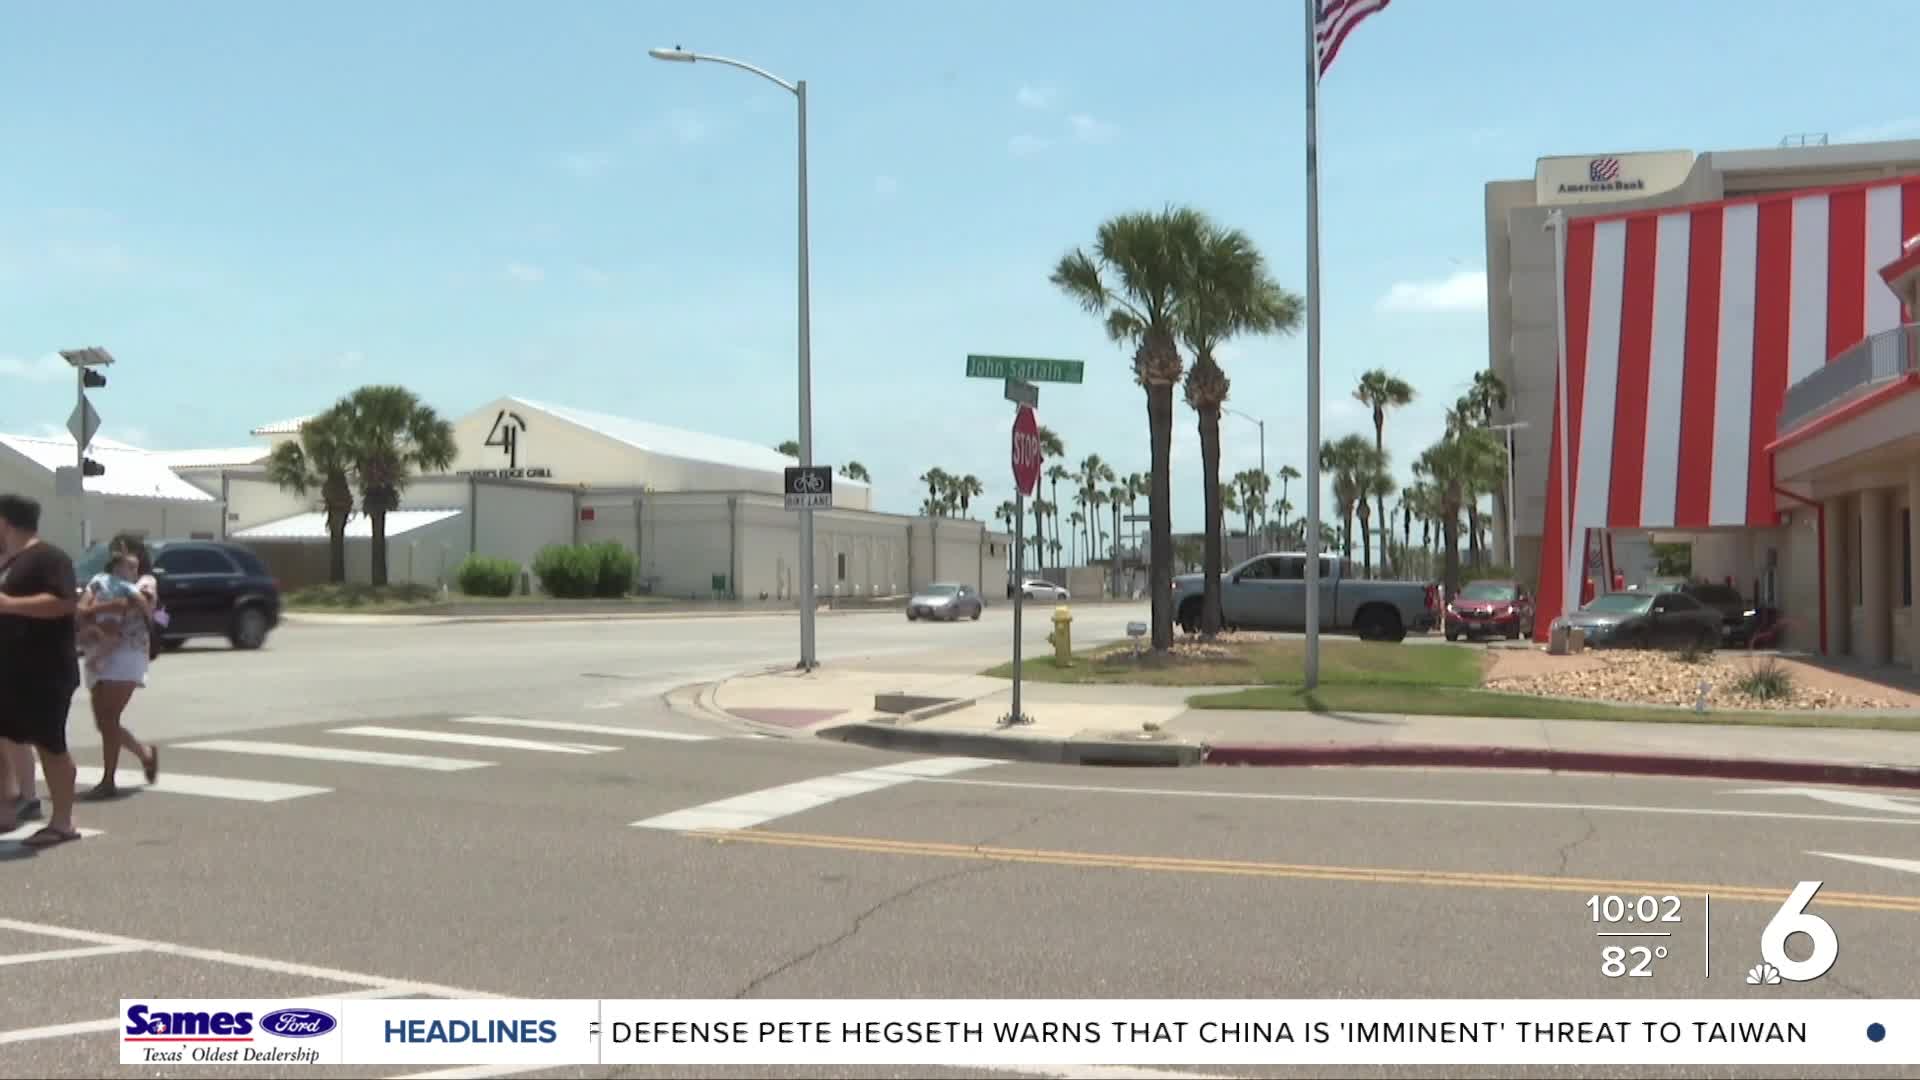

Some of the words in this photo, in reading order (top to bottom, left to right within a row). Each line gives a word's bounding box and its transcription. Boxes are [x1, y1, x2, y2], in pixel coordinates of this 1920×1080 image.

[969, 358, 1004, 377] John
[1009, 360, 1062, 380] Sartain
[1013, 432, 1038, 469] STOP
[808, 495, 830, 506] LANE
